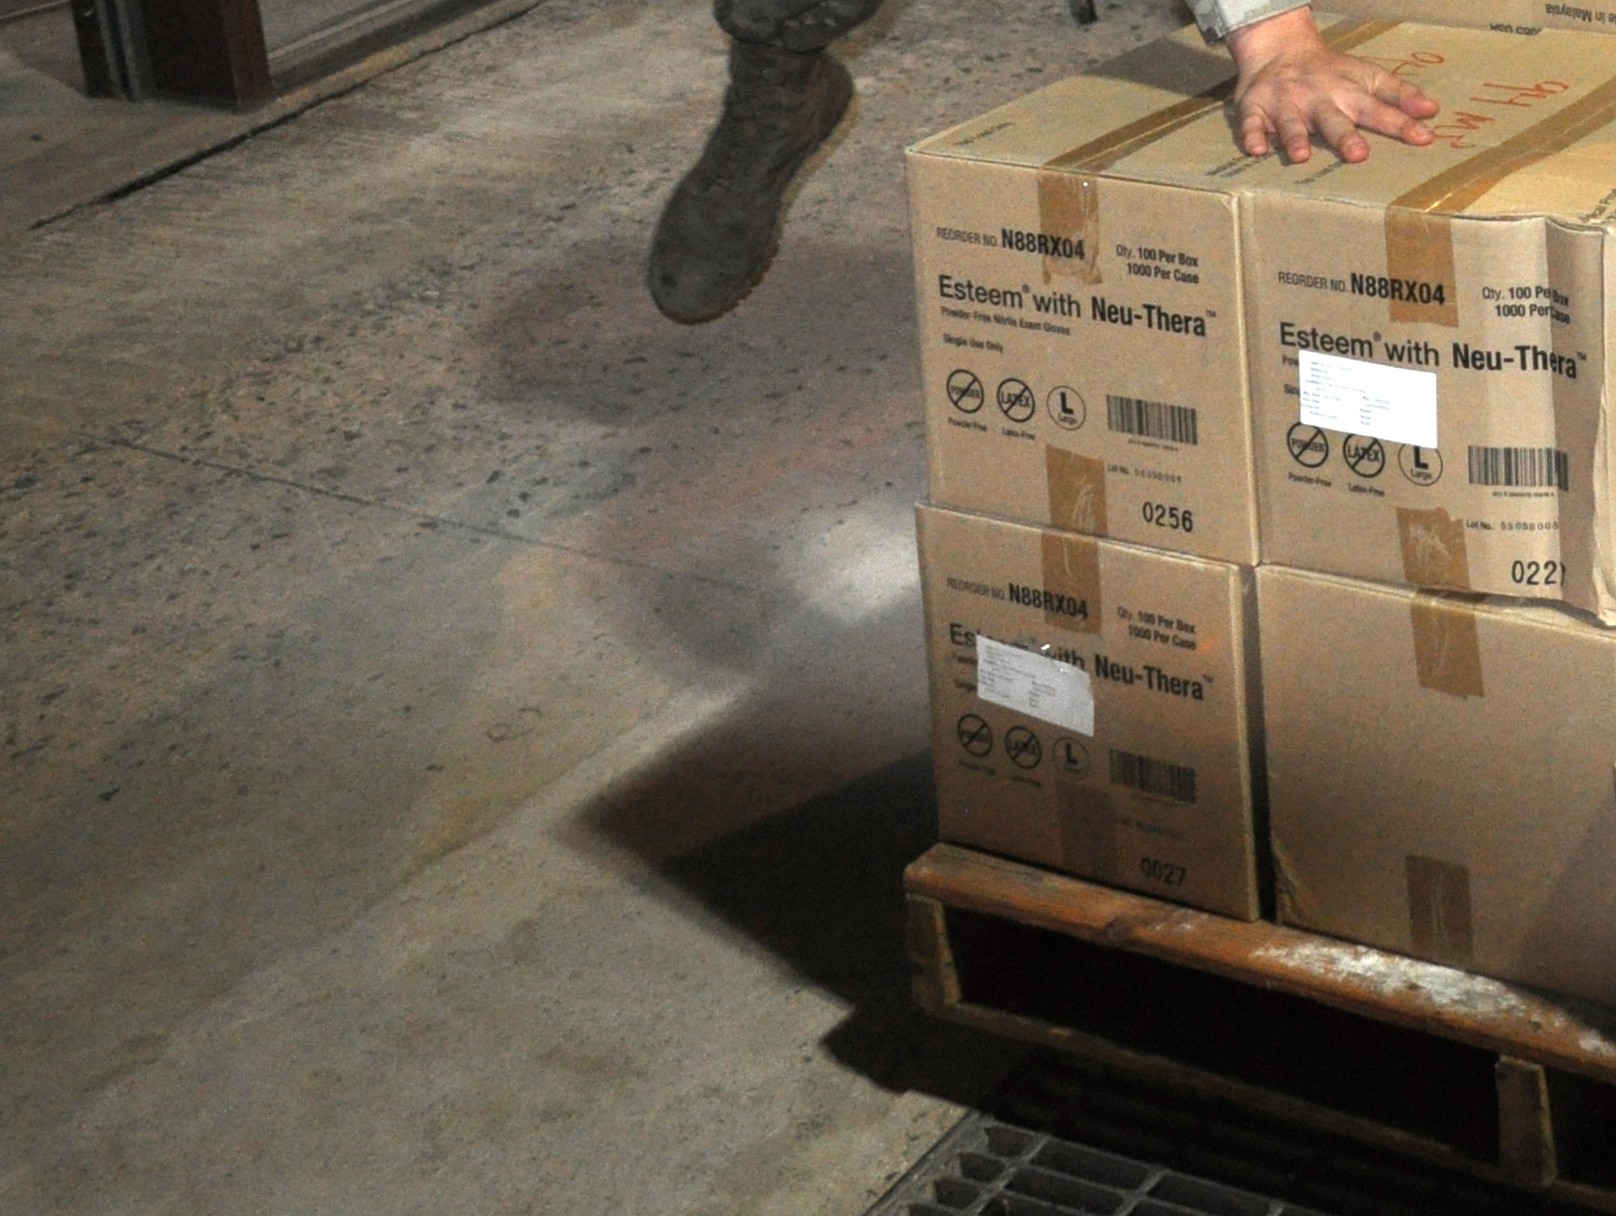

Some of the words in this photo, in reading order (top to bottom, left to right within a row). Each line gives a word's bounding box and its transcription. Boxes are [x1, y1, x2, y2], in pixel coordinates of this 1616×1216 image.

[1546, 3, 1592, 22] Malaysia
[1595, 11, 1606, 23] in
[936, 226, 982, 244] REORDER
[1001, 228, 1086, 261] N88RX04
[1116, 243, 1136, 261] Qty.
[1137, 246, 1156, 262] 100
[1159, 249, 1176, 264] Per
[1178, 251, 1199, 267] Box
[1127, 262, 1151, 278] 1000
[1154, 266, 1170, 280] Per
[1172, 268, 1199, 284] Case
[1278, 271, 1328, 290] REORDER
[1330, 279, 1348, 292] NO.
[1351, 273, 1446, 305] N88RX04
[1482, 287, 1505, 301] Qty.
[1508, 286, 1531, 299] 100
[1535, 286, 1552, 298] Pe
[1032, 291, 1081, 318] with
[1496, 304, 1525, 317] 1000
[1384, 339, 1440, 367] with
[1060, 392, 1074, 415] L
[1414, 446, 1428, 469] L
[1142, 501, 1194, 533] 0256
[1009, 582, 1089, 620] N88RX04
[1065, 742, 1078, 765] L
